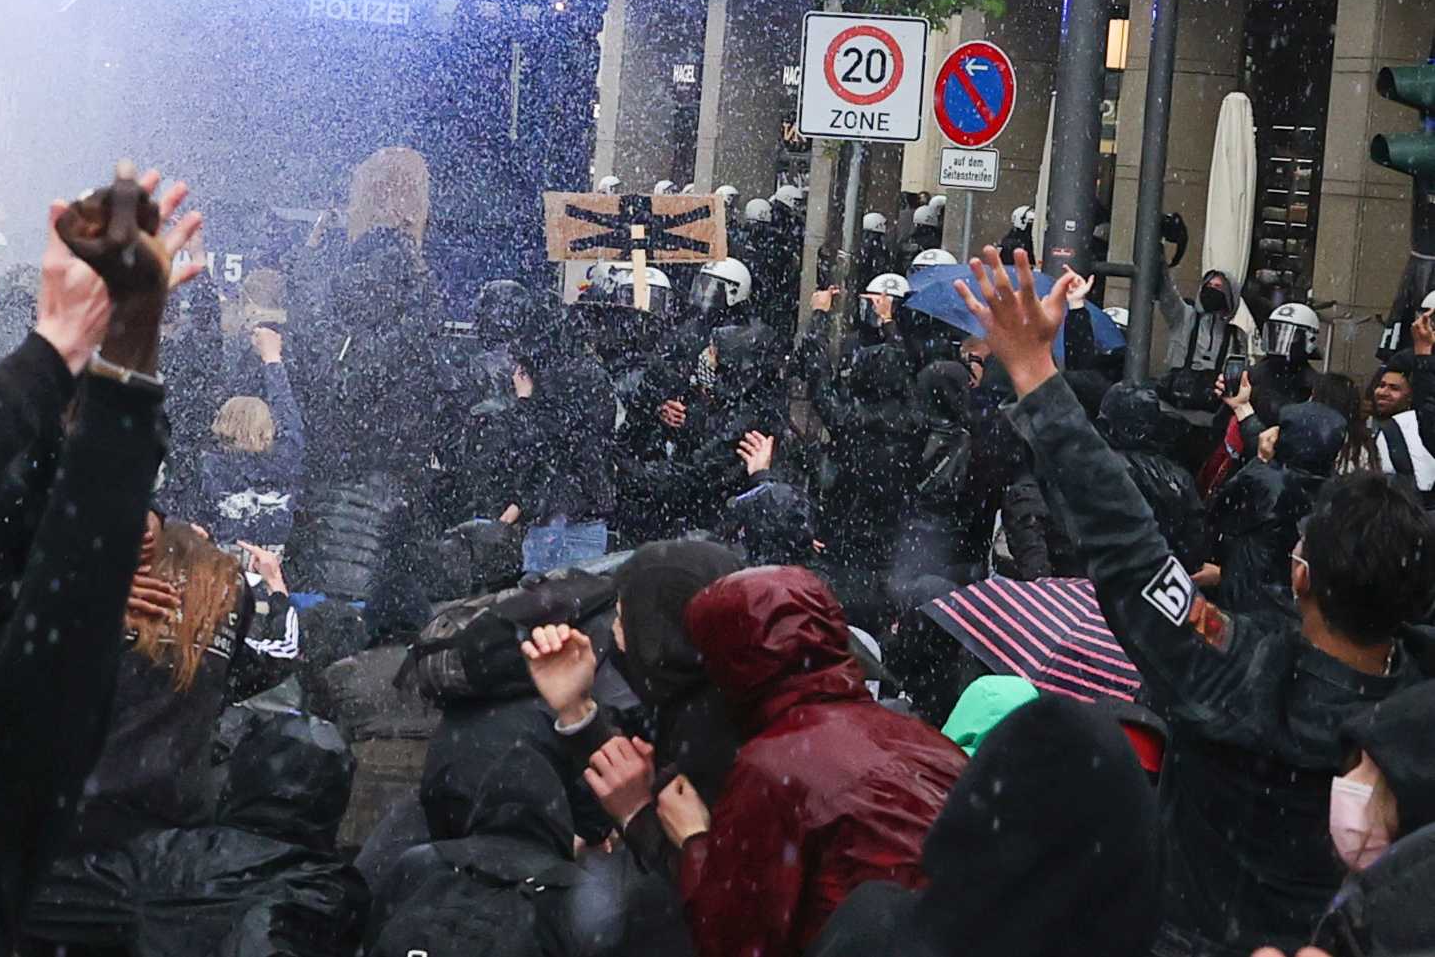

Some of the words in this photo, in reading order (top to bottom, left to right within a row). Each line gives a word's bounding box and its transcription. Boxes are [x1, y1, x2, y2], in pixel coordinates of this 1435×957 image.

[841, 47, 887, 84] 20
[829, 109, 891, 132] ZONE
[953, 156, 966, 167] auf
[968, 157, 984, 168] dem
[942, 168, 993, 183] Seitenstreifen
